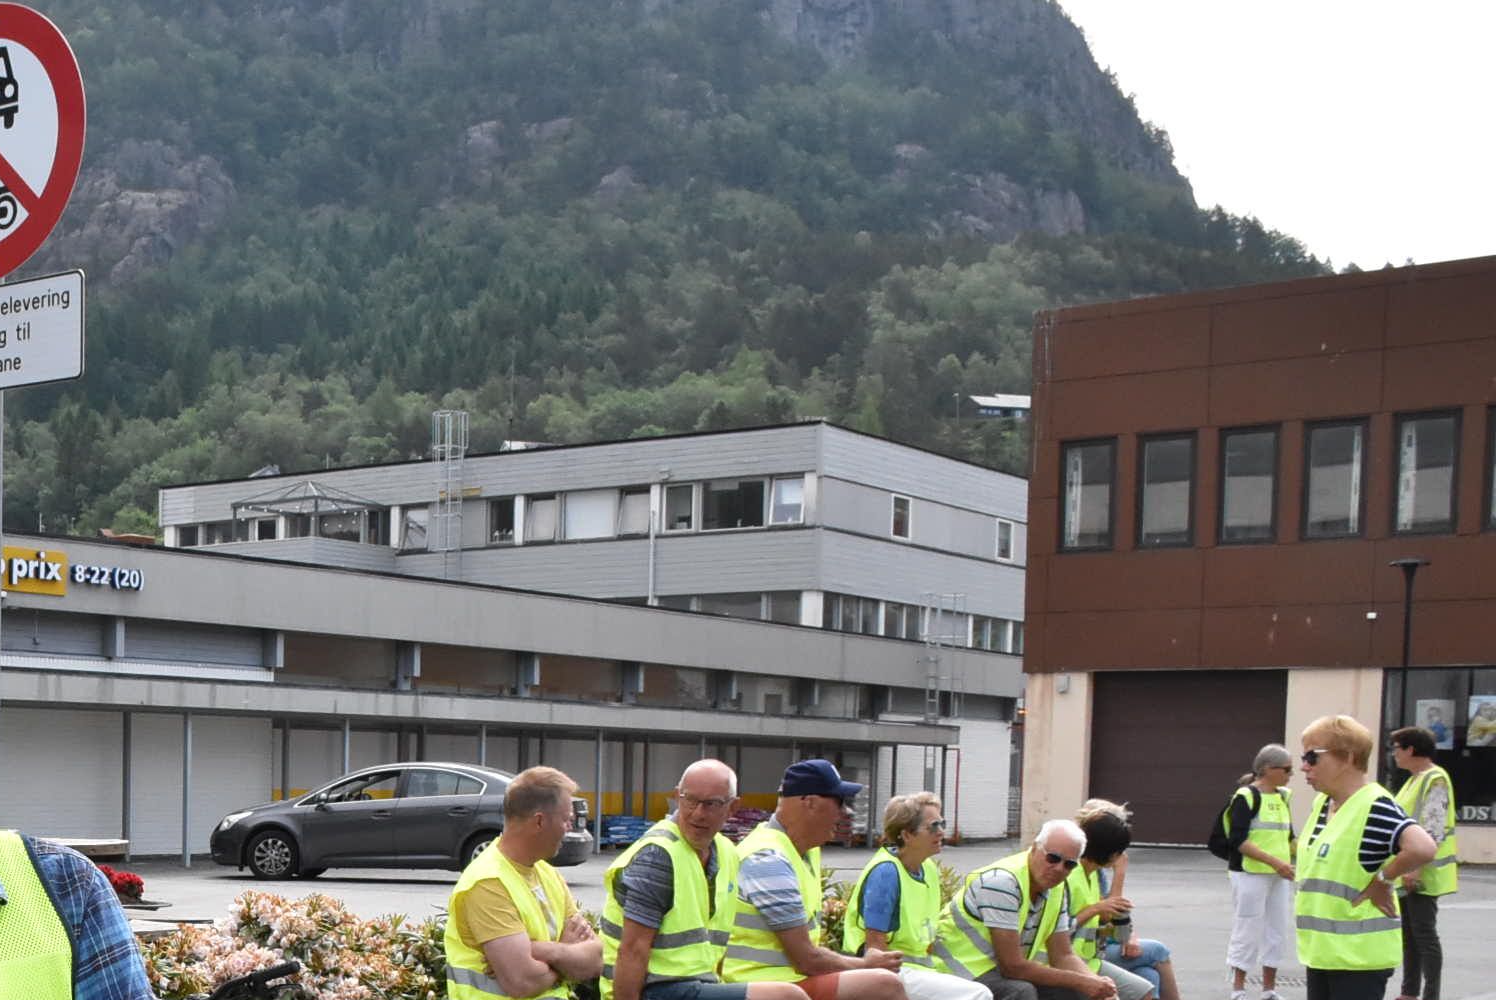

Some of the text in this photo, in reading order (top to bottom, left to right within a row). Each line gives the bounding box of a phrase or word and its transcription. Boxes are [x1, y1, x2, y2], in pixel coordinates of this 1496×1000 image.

[16, 322, 31, 342] til
[11, 551, 62, 585] prix
[74, 564, 110, 585] 8-22
[114, 567, 145, 591] (20)
